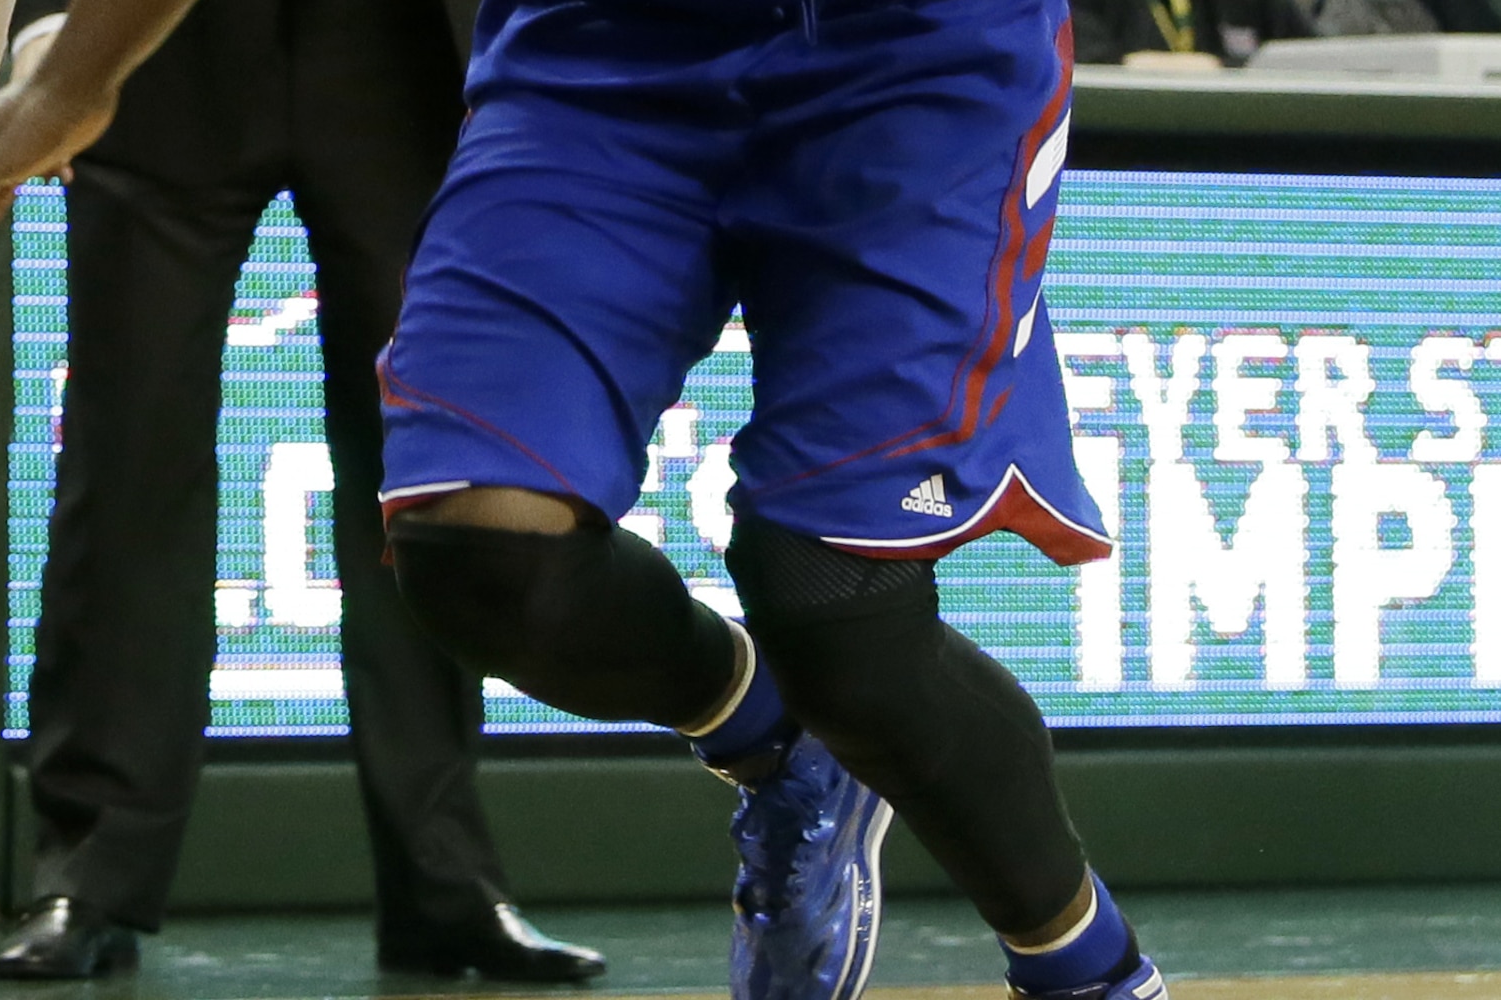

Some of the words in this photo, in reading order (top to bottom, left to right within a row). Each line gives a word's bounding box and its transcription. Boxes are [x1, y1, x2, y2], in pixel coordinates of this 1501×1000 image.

[1410, 334, 1501, 462] S
[901, 496, 953, 518] adidas
[1073, 458, 1501, 691] IMP
